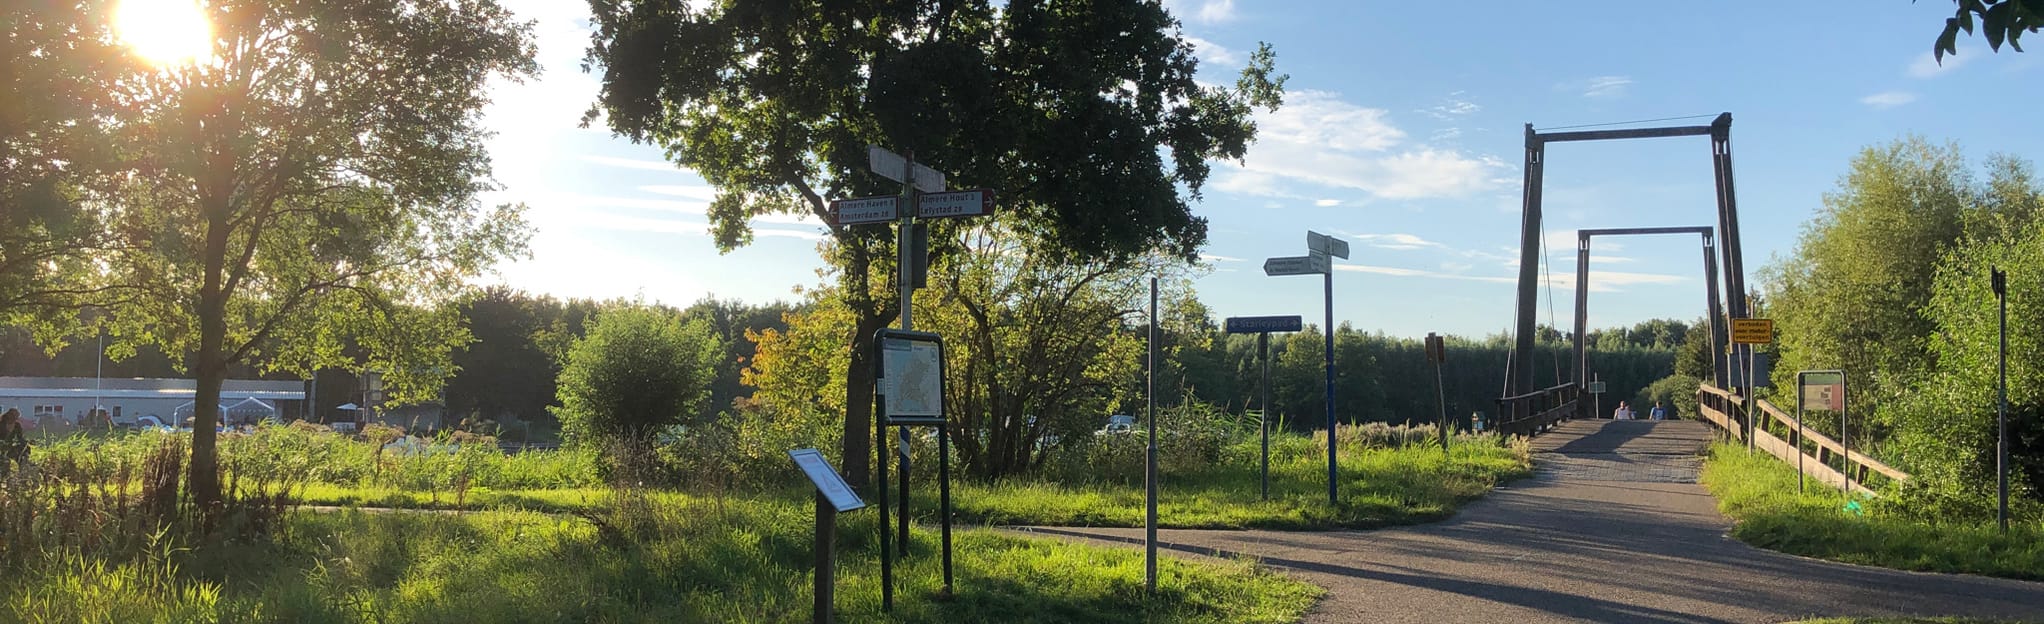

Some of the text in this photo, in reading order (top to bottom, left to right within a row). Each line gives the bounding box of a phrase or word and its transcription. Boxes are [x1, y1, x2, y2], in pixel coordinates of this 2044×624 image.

[920, 195, 948, 204] Almere
[949, 193, 969, 201] Hout
[866, 200, 888, 208] Haven
[920, 206, 952, 215] Lelystad
[840, 211, 880, 219] Amsterdam
